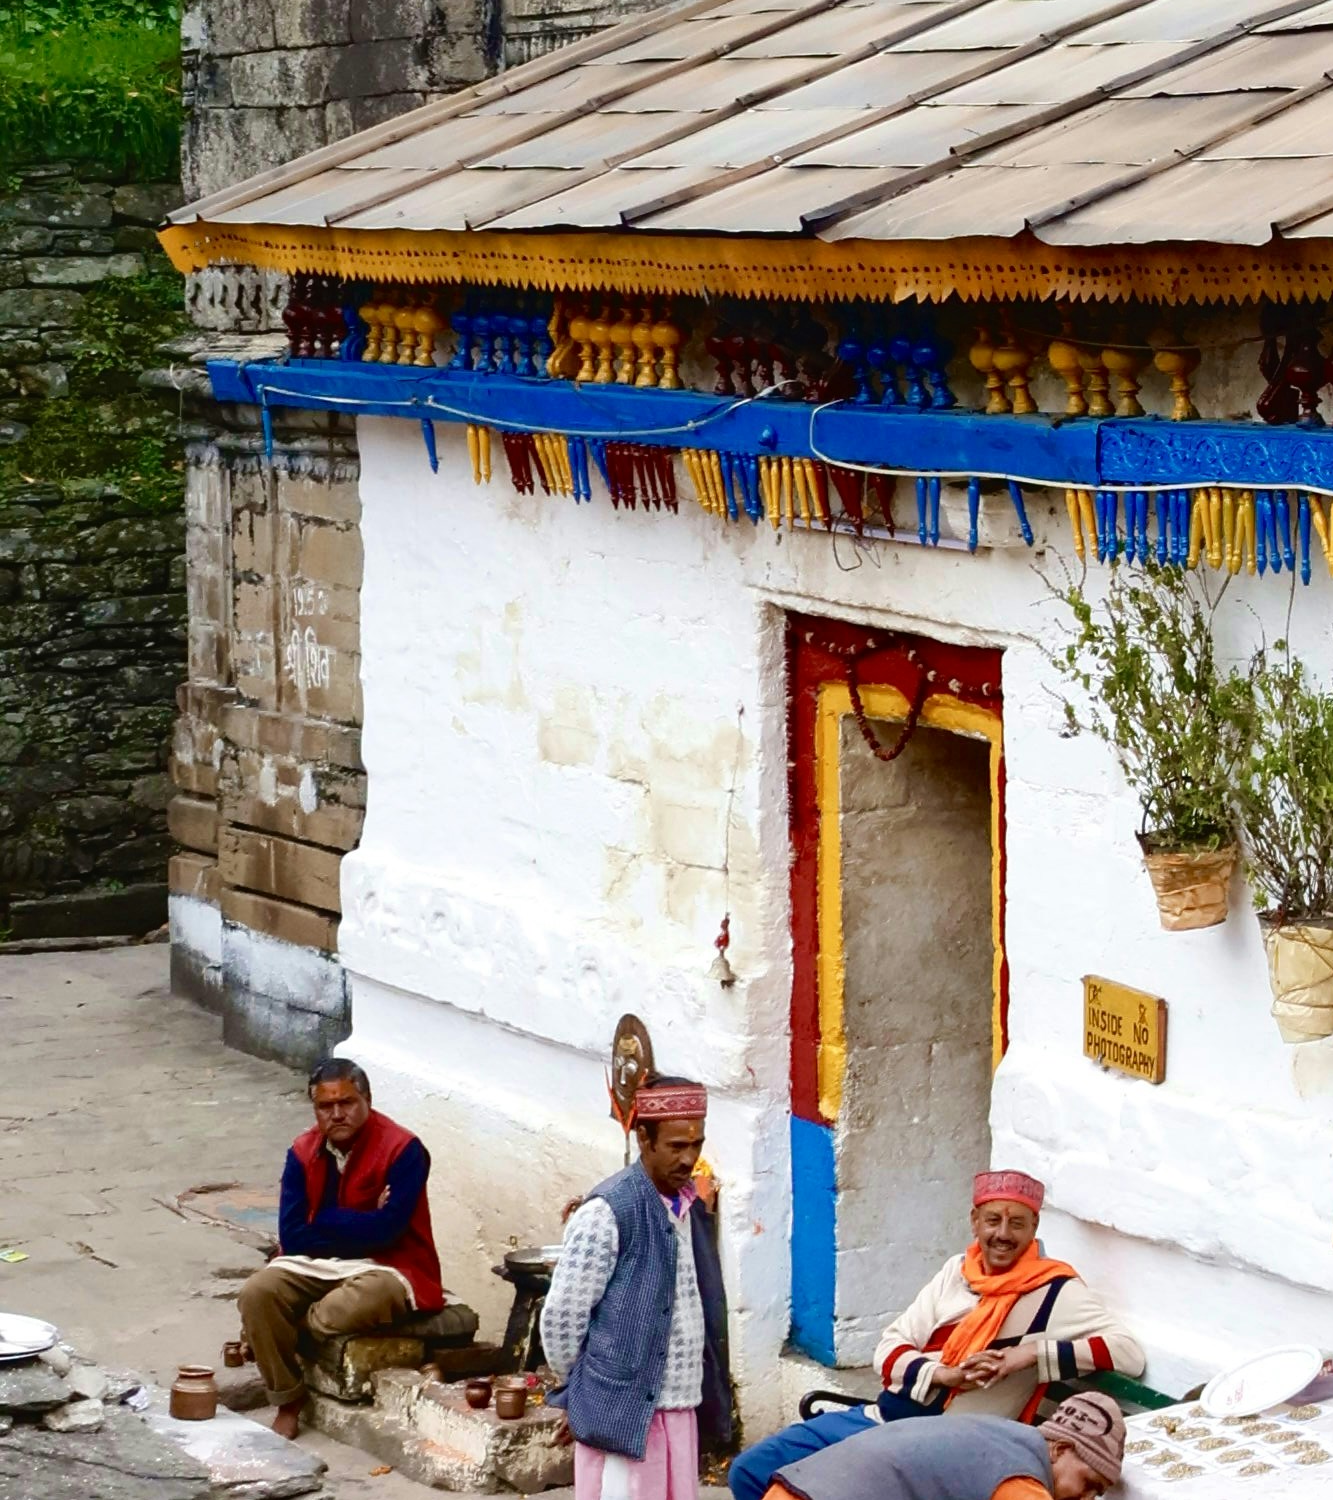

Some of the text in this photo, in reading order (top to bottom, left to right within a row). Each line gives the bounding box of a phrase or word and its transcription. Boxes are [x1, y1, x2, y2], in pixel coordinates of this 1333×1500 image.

[1088, 1006, 1149, 1045] INSIDE NO
[1086, 1031, 1155, 1077] PHOTOGRAPHY
